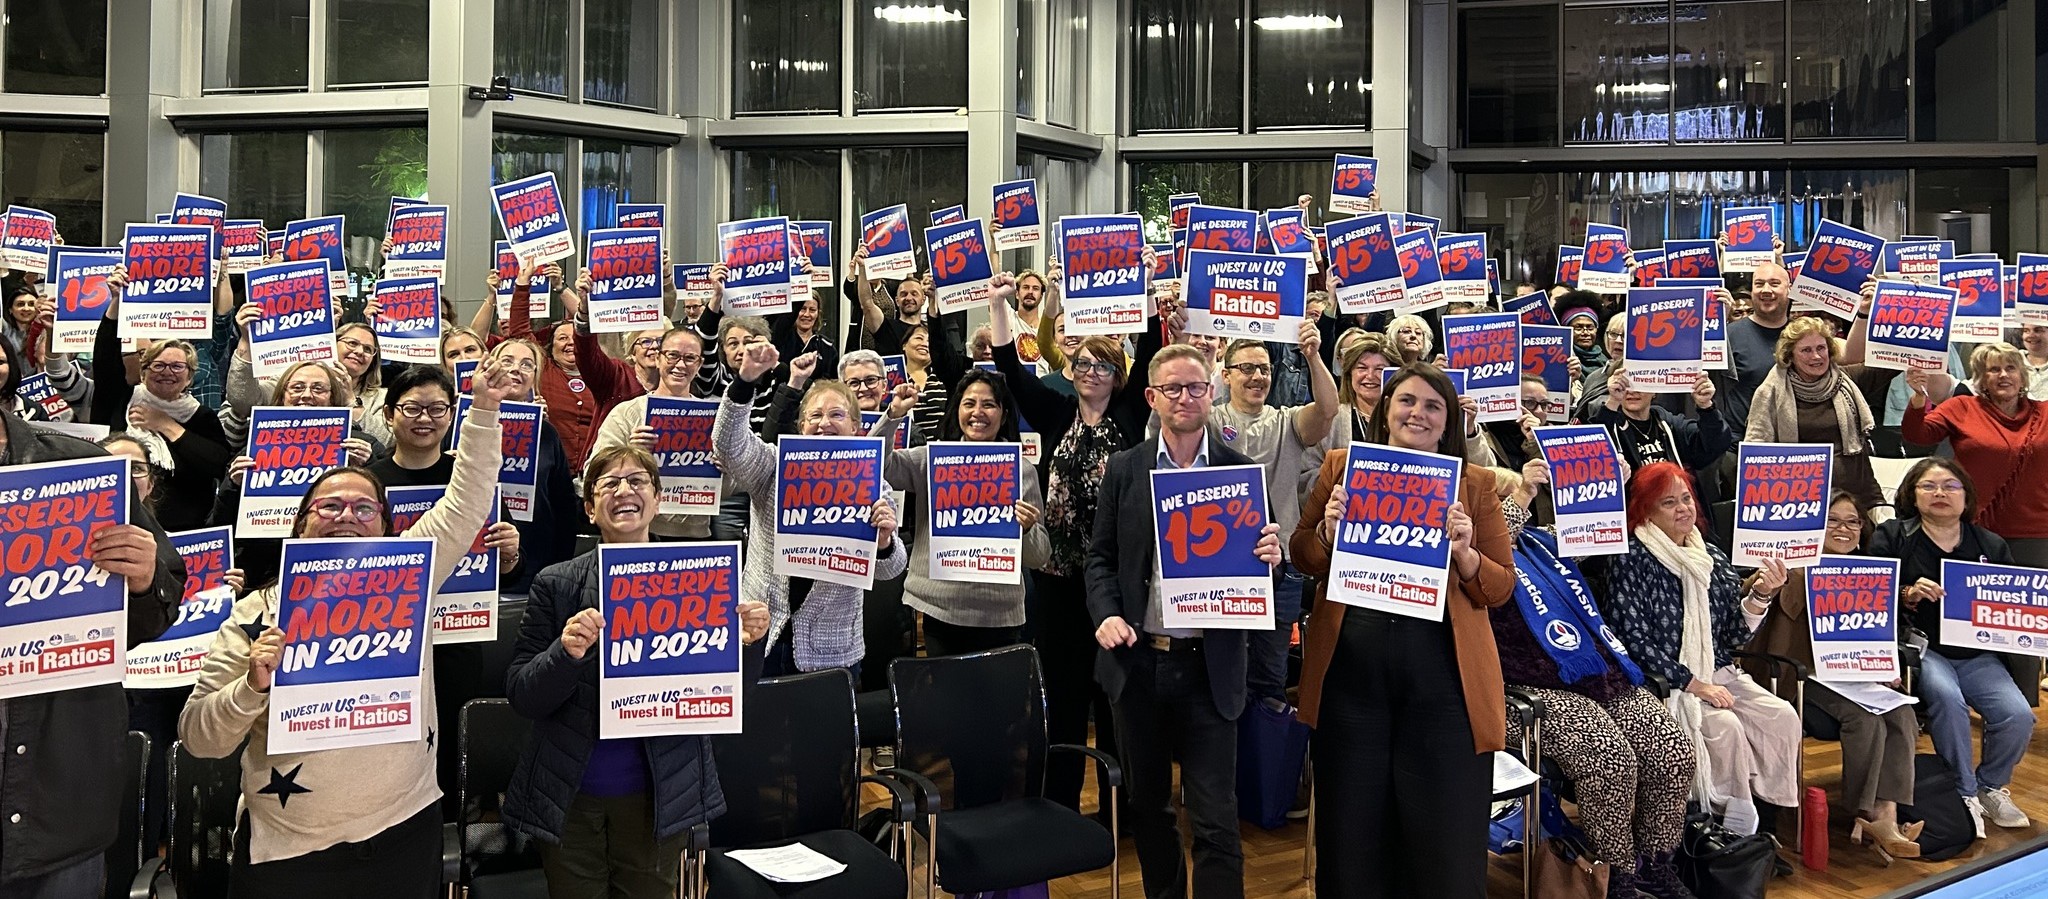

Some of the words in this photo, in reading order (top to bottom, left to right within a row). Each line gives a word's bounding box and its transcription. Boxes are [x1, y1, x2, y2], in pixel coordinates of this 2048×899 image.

[1336, 170, 1374, 190] 15%
[503, 187, 554, 211] DESERVE
[995, 194, 1034, 223] 15%
[177, 208, 190, 216] WE
[192, 208, 223, 218] DESERVE
[394, 217, 443, 229] DESERVE
[507, 198, 558, 228] MORE
[8, 227, 51, 240] MORE
[510, 225, 523, 239] IN
[526, 212, 560, 233] 2024
[1192, 221, 1206, 231] WE
[1208, 221, 1248, 229] DESERVE
[1728, 221, 1770, 246] 15%
[20, 238, 49, 248] 2024
[392, 228, 443, 244] MORE
[725, 231, 784, 249] DESERVE
[931, 240, 942, 251] WE
[944, 229, 975, 244] DESERVE
[1067, 231, 1138, 252] DESERVE
[1273, 224, 1302, 248] 15%
[1331, 235, 1344, 248] WE
[1345, 224, 1382, 242] DESERVE
[1835, 238, 1874, 252] DESERVE
[130, 242, 206, 257] DESERVE
[286, 233, 339, 261] 15%
[407, 241, 441, 253] 2024
[592, 243, 656, 260] DESERVE
[726, 244, 784, 267] MORE
[1335, 234, 1390, 278] 15%
[1587, 241, 1627, 265] 15%
[1668, 252, 1679, 260] WE
[1680, 248, 1710, 258] DESERVE
[1895, 246, 1917, 255] INVEST
[592, 256, 656, 280] MORE
[934, 238, 982, 279] 15%
[1069, 247, 1140, 275] MORE
[1208, 262, 1247, 276] INVEST
[1248, 262, 1262, 272] IN
[1264, 261, 1286, 276] US
[1440, 248, 1483, 275] 15%
[1812, 244, 1872, 273] 15%
[1901, 262, 1938, 271] Ratios
[63, 268, 80, 279] WE
[128, 257, 206, 281] MORE
[746, 261, 784, 279] 2024
[1070, 274, 1088, 291] IN
[1093, 267, 1139, 287] 2024
[1957, 268, 1994, 279] DESERVE
[127, 280, 149, 296] IN
[153, 277, 204, 294] 2024
[252, 275, 324, 299] DESERVE
[613, 274, 655, 291] 2024
[1215, 275, 1261, 290] Invest
[1263, 278, 1276, 291] in
[378, 289, 434, 305] DESERVE
[761, 297, 785, 305] Ratios
[1214, 293, 1276, 315] Ratios
[1376, 291, 1402, 302] Ratios
[1828, 297, 1852, 311] Ratios
[1878, 296, 1950, 310] DESERVE
[629, 311, 657, 320] Ratios
[1110, 313, 1140, 322] Ratios
[1632, 305, 1649, 316] WE
[1651, 299, 1695, 312] DESERVE
[171, 319, 204, 327] Ratios
[256, 320, 275, 336] IN
[279, 308, 325, 330] 2024
[395, 317, 434, 332] 2024
[1875, 309, 1948, 327] MORE
[1451, 328, 1515, 348] DESERVE
[1631, 310, 1699, 350] 15%
[1873, 325, 1892, 337] IN
[1895, 325, 1944, 340] 2024
[300, 350, 330, 361] Ratios
[1453, 343, 1516, 368] MORE
[1472, 361, 1514, 380] 2024
[1667, 375, 1696, 383] Ratios
[1489, 400, 1515, 411] Ratios
[256, 427, 343, 445] DESERVE
[253, 444, 341, 471] MORE
[1548, 442, 1611, 462] DESERVE
[784, 460, 876, 480] DESERVE
[935, 463, 1014, 482] DESERVE
[1556, 457, 1616, 487] MORE
[1744, 463, 1825, 480] DESERVE
[39, 474, 118, 499] MIDWIVES
[783, 480, 875, 508] MORE
[1350, 470, 1451, 498] DESERVE
[1558, 487, 1574, 506] IN
[1578, 480, 1617, 502] 2024
[1743, 479, 1824, 505] MORE
[682, 494, 713, 503] Ratios
[936, 482, 1015, 509] MORE
[1161, 494, 1184, 512] WE
[1187, 483, 1249, 504] DESERVE
[783, 508, 807, 526] IN
[812, 505, 872, 524] 2024
[936, 509, 957, 528] IN
[962, 505, 1013, 526] 2024
[1346, 493, 1448, 527] MORE
[1742, 506, 1766, 522] IN
[1769, 501, 1821, 520] 2024
[1165, 499, 1261, 564] 15%
[1343, 522, 1372, 544] IN
[1375, 524, 1442, 548] 2024
[609, 562, 655, 576] NURSES
[658, 561, 668, 571] &
[670, 556, 731, 571] MIDWIVES
[5, 565, 110, 607] 2024
[289, 567, 424, 601] DESERVE
[610, 569, 731, 600] DESERVE
[1513, 563, 1548, 616] ciation
[1813, 576, 1891, 590] DESERVE
[1966, 575, 2013, 587] INVEST
[2014, 575, 2030, 586] IN
[1815, 591, 1890, 616] MORE
[1977, 587, 2027, 604] Invest
[1177, 603, 1208, 612] Invest
[1211, 603, 1220, 612] in
[1224, 600, 1264, 612] Ratios
[285, 593, 420, 644] MORE
[611, 593, 731, 640] MORE
[1816, 616, 1835, 634] IN
[1839, 611, 1888, 630] 2024
[1977, 605, 2048, 630] Ratios
[282, 642, 320, 673] IN
[325, 628, 413, 665] 2024
[610, 638, 643, 666] IN
[649, 626, 729, 660] 2024
[43, 648, 110, 669] Ratios
[611, 695, 647, 709] INVEST
[648, 693, 659, 703] IN
[661, 691, 680, 703] US
[620, 706, 658, 719] Invest
[662, 706, 673, 717] in
[679, 701, 730, 716] Ratios
